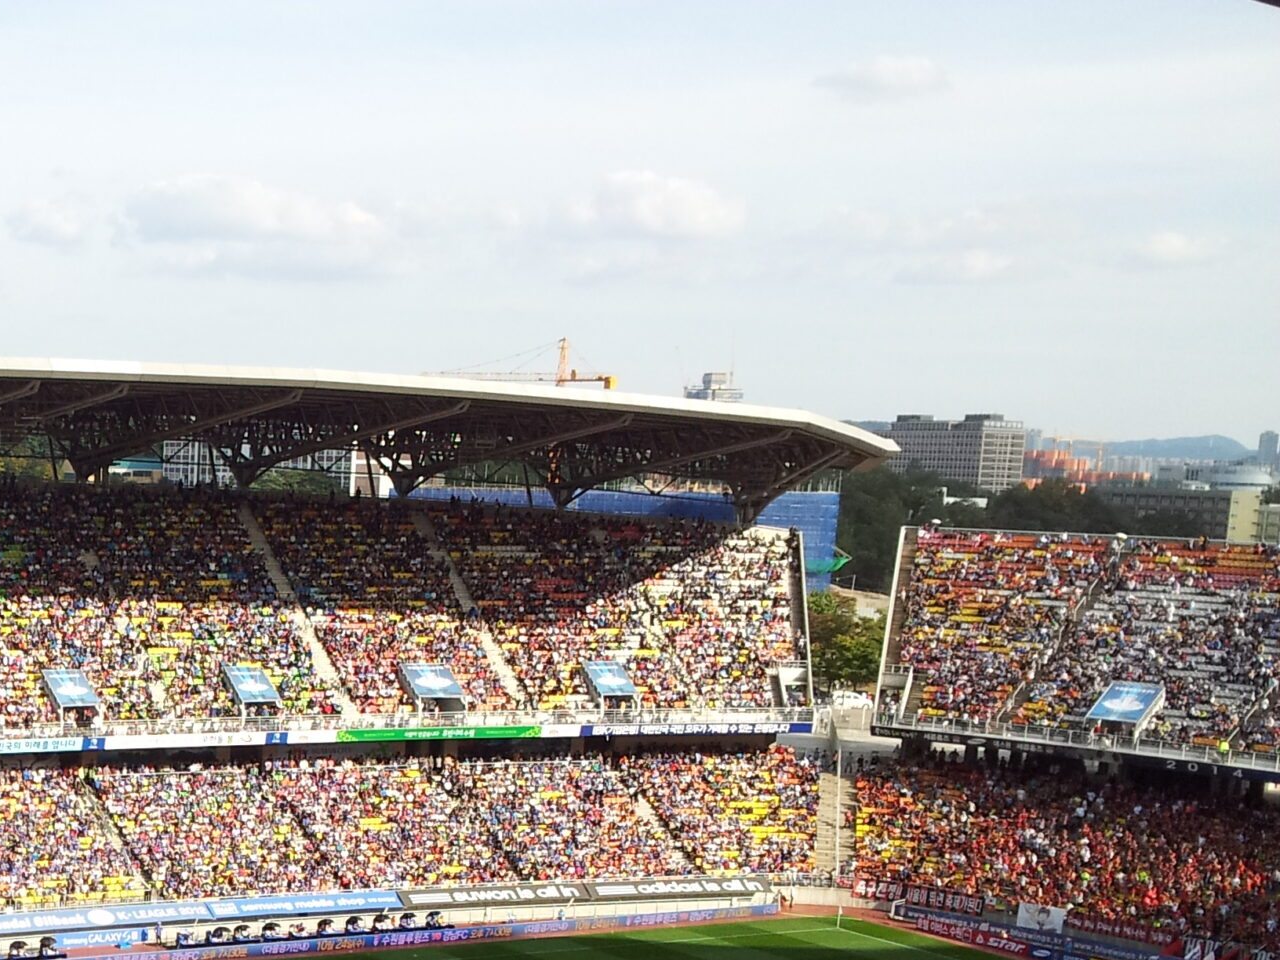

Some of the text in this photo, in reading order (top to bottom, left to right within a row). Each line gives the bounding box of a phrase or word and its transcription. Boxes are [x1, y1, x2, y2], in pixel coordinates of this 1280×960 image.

[453, 890, 517, 902] suwon
[560, 885, 580, 896] in
[637, 882, 703, 894] adidas
[743, 879, 764, 890] in
